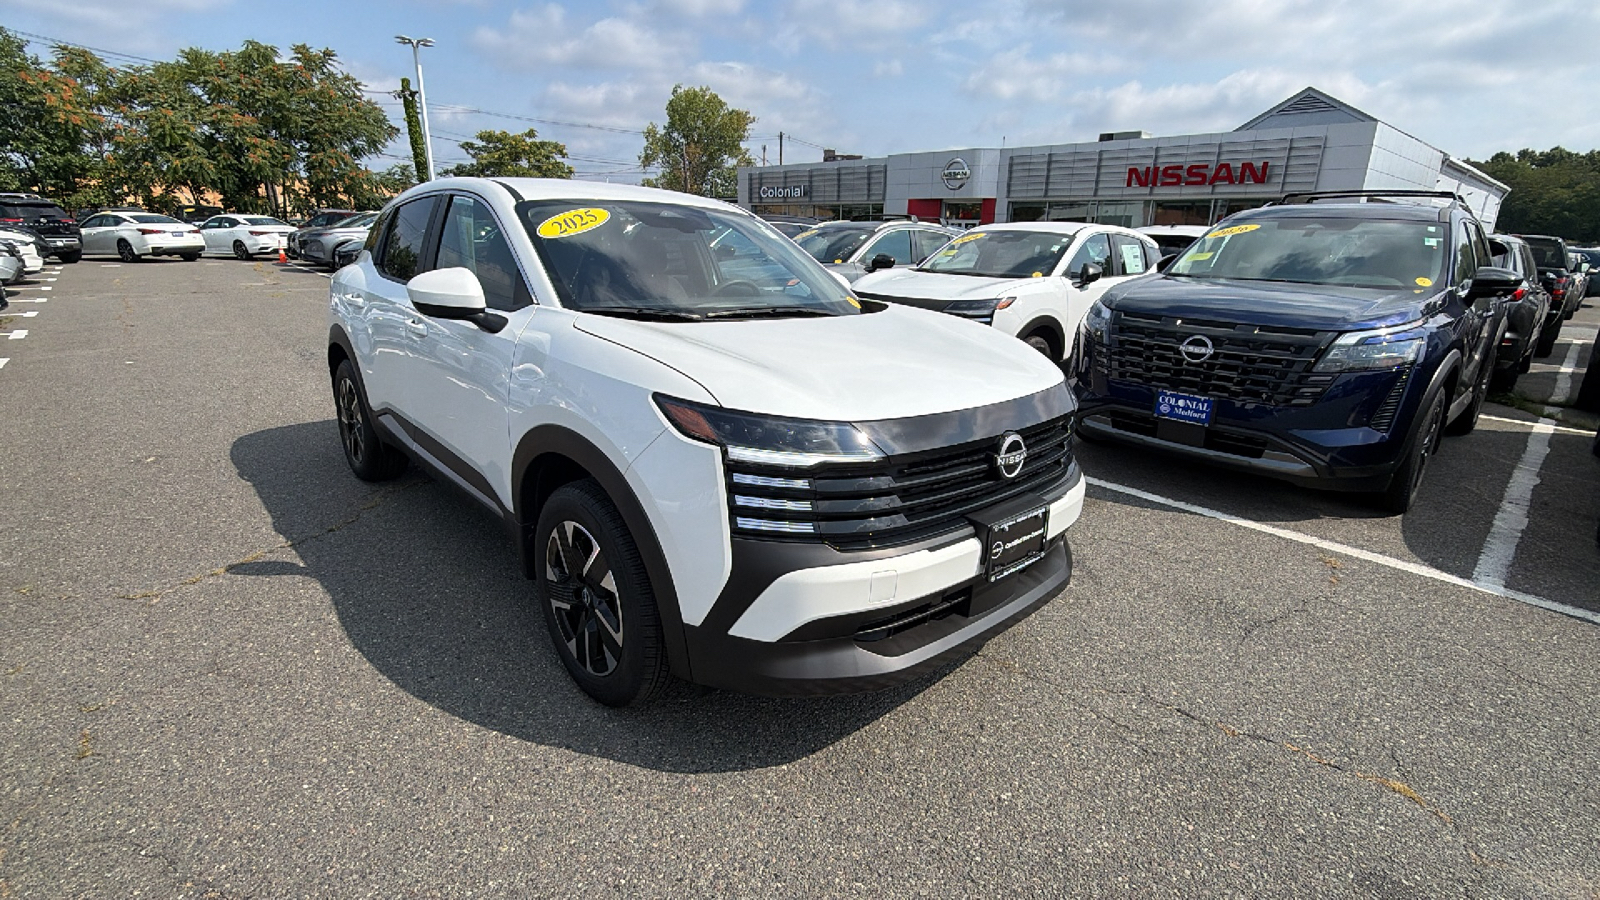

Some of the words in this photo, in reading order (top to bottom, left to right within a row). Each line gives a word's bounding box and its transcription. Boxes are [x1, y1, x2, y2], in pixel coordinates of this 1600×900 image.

[1126, 161, 1270, 188] NISSAN
[760, 184, 804, 198] Colonial
[551, 209, 598, 234] 2025
[1179, 345, 1214, 355] NISSAN
[1173, 407, 1206, 419] Medford
[997, 452, 1027, 466] NISSAN
